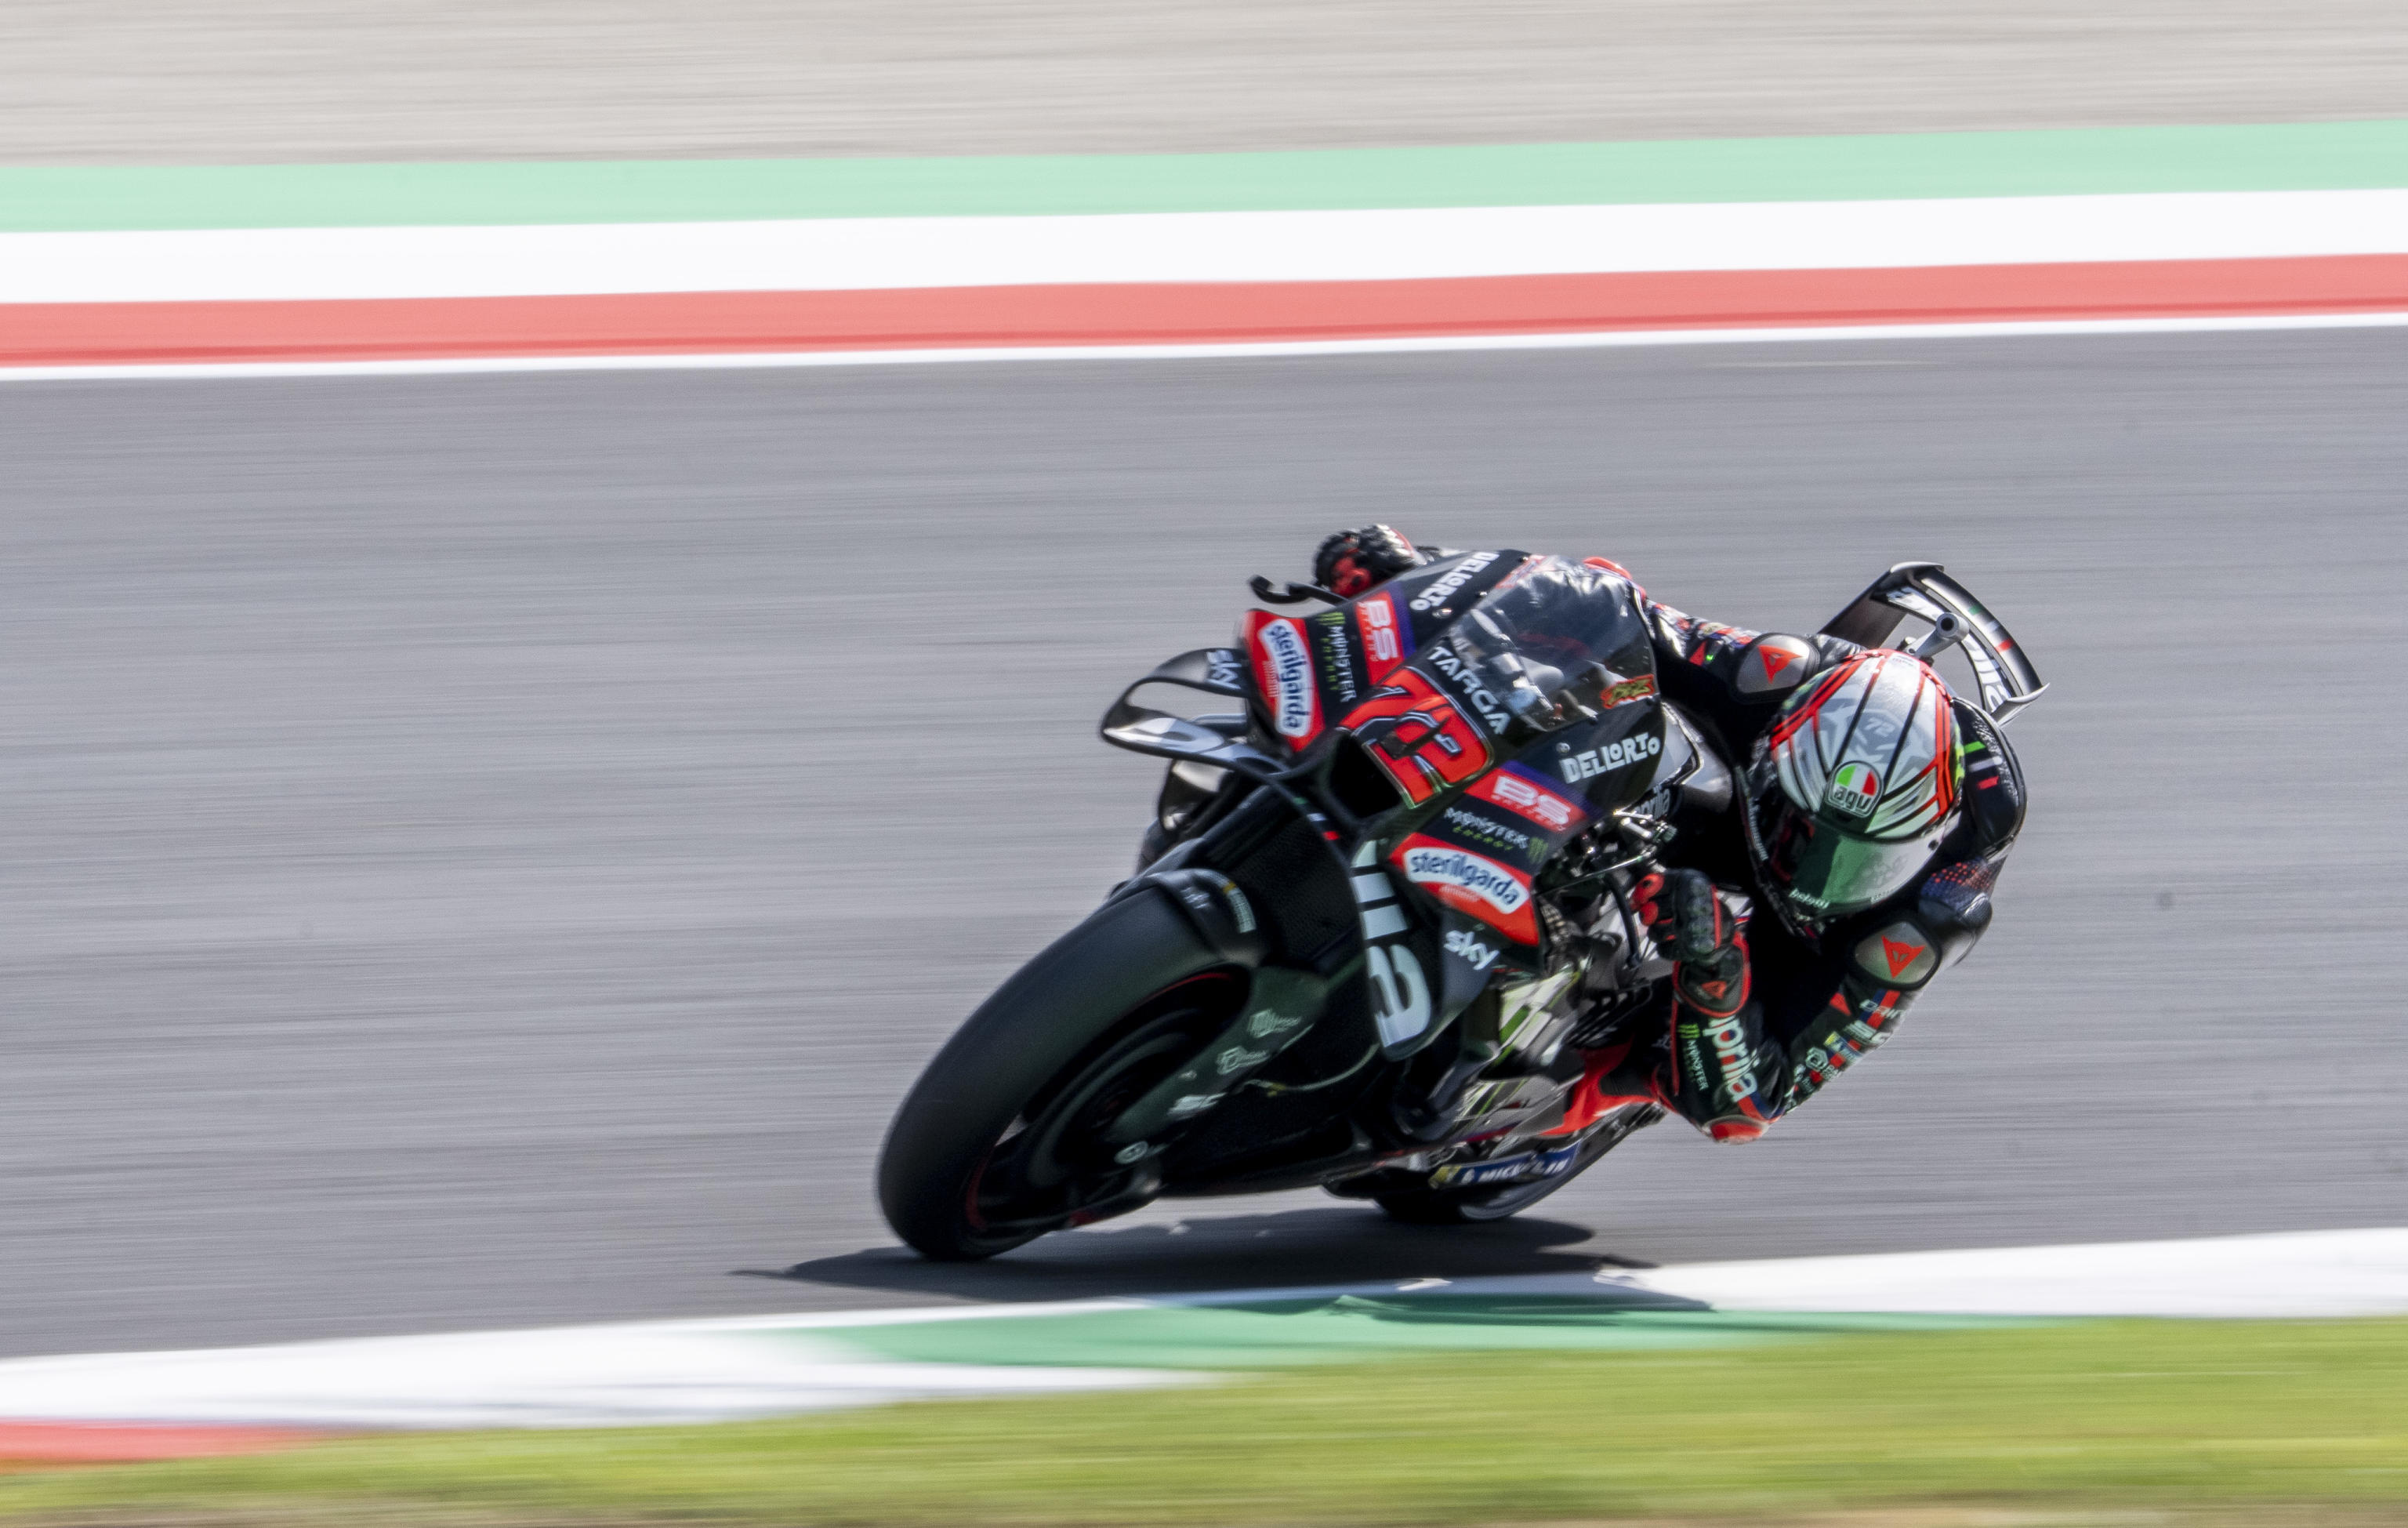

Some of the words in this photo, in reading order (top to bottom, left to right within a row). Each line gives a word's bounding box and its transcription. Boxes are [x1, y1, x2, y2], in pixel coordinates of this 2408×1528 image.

[1364, 599, 1399, 661] BS
[1267, 624, 1312, 729] sterilgarda
[1328, 626, 1358, 703] MONSTER
[1427, 646, 1510, 735] TARGA
[1558, 731, 1661, 784] DELLORTO
[1492, 775, 1572, 825] BS
[1443, 806, 1529, 850] MONSTER
[1411, 851, 1520, 906] sterilgarda
[1444, 929, 1500, 971] sky
[1687, 1039, 1710, 1091] MONSTER
